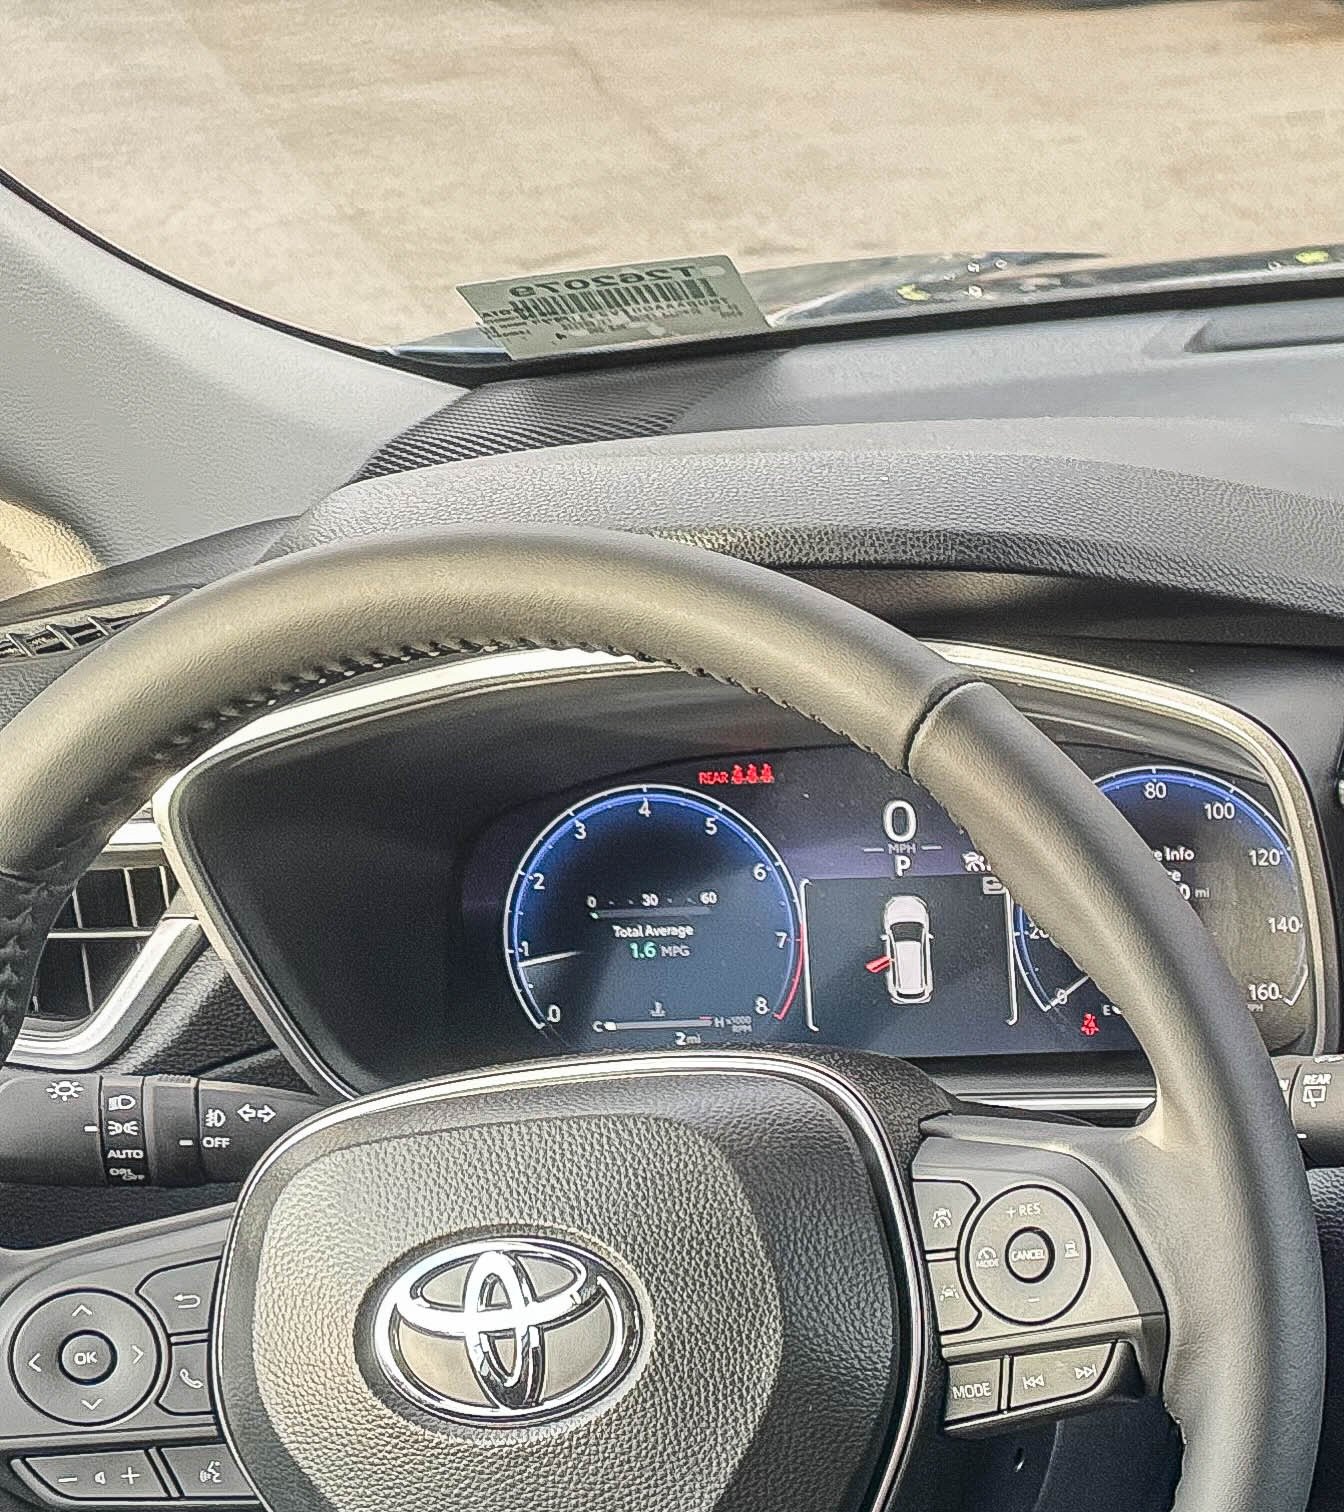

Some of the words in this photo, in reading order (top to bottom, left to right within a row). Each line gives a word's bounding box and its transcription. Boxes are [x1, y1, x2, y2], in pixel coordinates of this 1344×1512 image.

[699, 772, 728, 785] REAR
[1143, 782, 1167, 799] 80
[638, 801, 651, 817] 4
[1204, 802, 1235, 820] 100
[705, 817, 718, 835] 5
[883, 799, 918, 842] 0
[574, 821, 587, 840] 3
[888, 843, 917, 854] MPH
[1166, 847, 1195, 862] Info
[895, 855, 912, 877] P
[1249, 850, 1281, 866] 120
[753, 863, 768, 881] 6
[532, 873, 546, 891] 2
[587, 896, 597, 908] 0
[641, 894, 659, 907] 30
[700, 892, 718, 905] 60
[1195, 888, 1211, 898] mi
[612, 925, 645, 938] Total
[645, 924, 694, 939] Average
[1268, 917, 1300, 933] 140
[521, 940, 530, 957] 1
[775, 932, 788, 949] 7
[629, 943, 657, 959] 1.6
[661, 944, 691, 957] MPG
[1248, 984, 1280, 1001] 160
[755, 996, 769, 1014] 8
[1103, 1004, 1111, 1015] E
[548, 1004, 561, 1023] 0
[592, 1020, 604, 1033] C
[714, 1016, 725, 1028] H
[1302, 1072, 1333, 1086] REAR
[202, 1137, 231, 1149] OFF
[107, 1149, 144, 1160] AUTO
[1018, 1202, 1041, 1218] RES
[1010, 1246, 1047, 1263] CANCEL
[74, 1351, 98, 1366] OK
[952, 1380, 992, 1399] MODE
